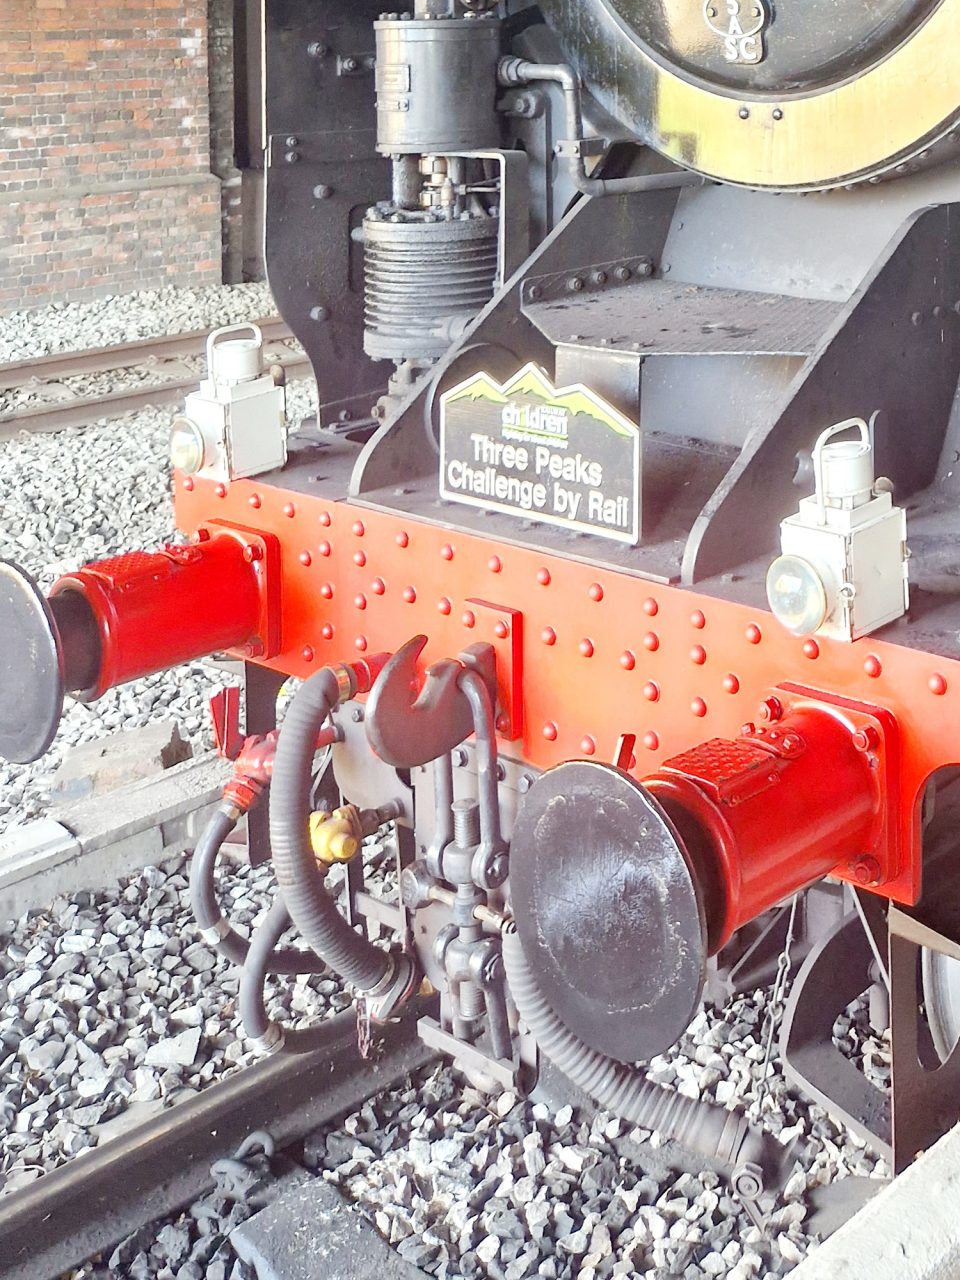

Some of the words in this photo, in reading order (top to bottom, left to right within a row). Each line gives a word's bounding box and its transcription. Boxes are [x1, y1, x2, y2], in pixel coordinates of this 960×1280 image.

[728, 15, 743, 35] A
[725, 36, 757, 60] SC
[470, 433, 529, 471] Three
[535, 446, 603, 487] Peaks
[447, 460, 547, 509] Challenge
[553, 482, 582, 520] by
[588, 489, 629, 528] Rail
